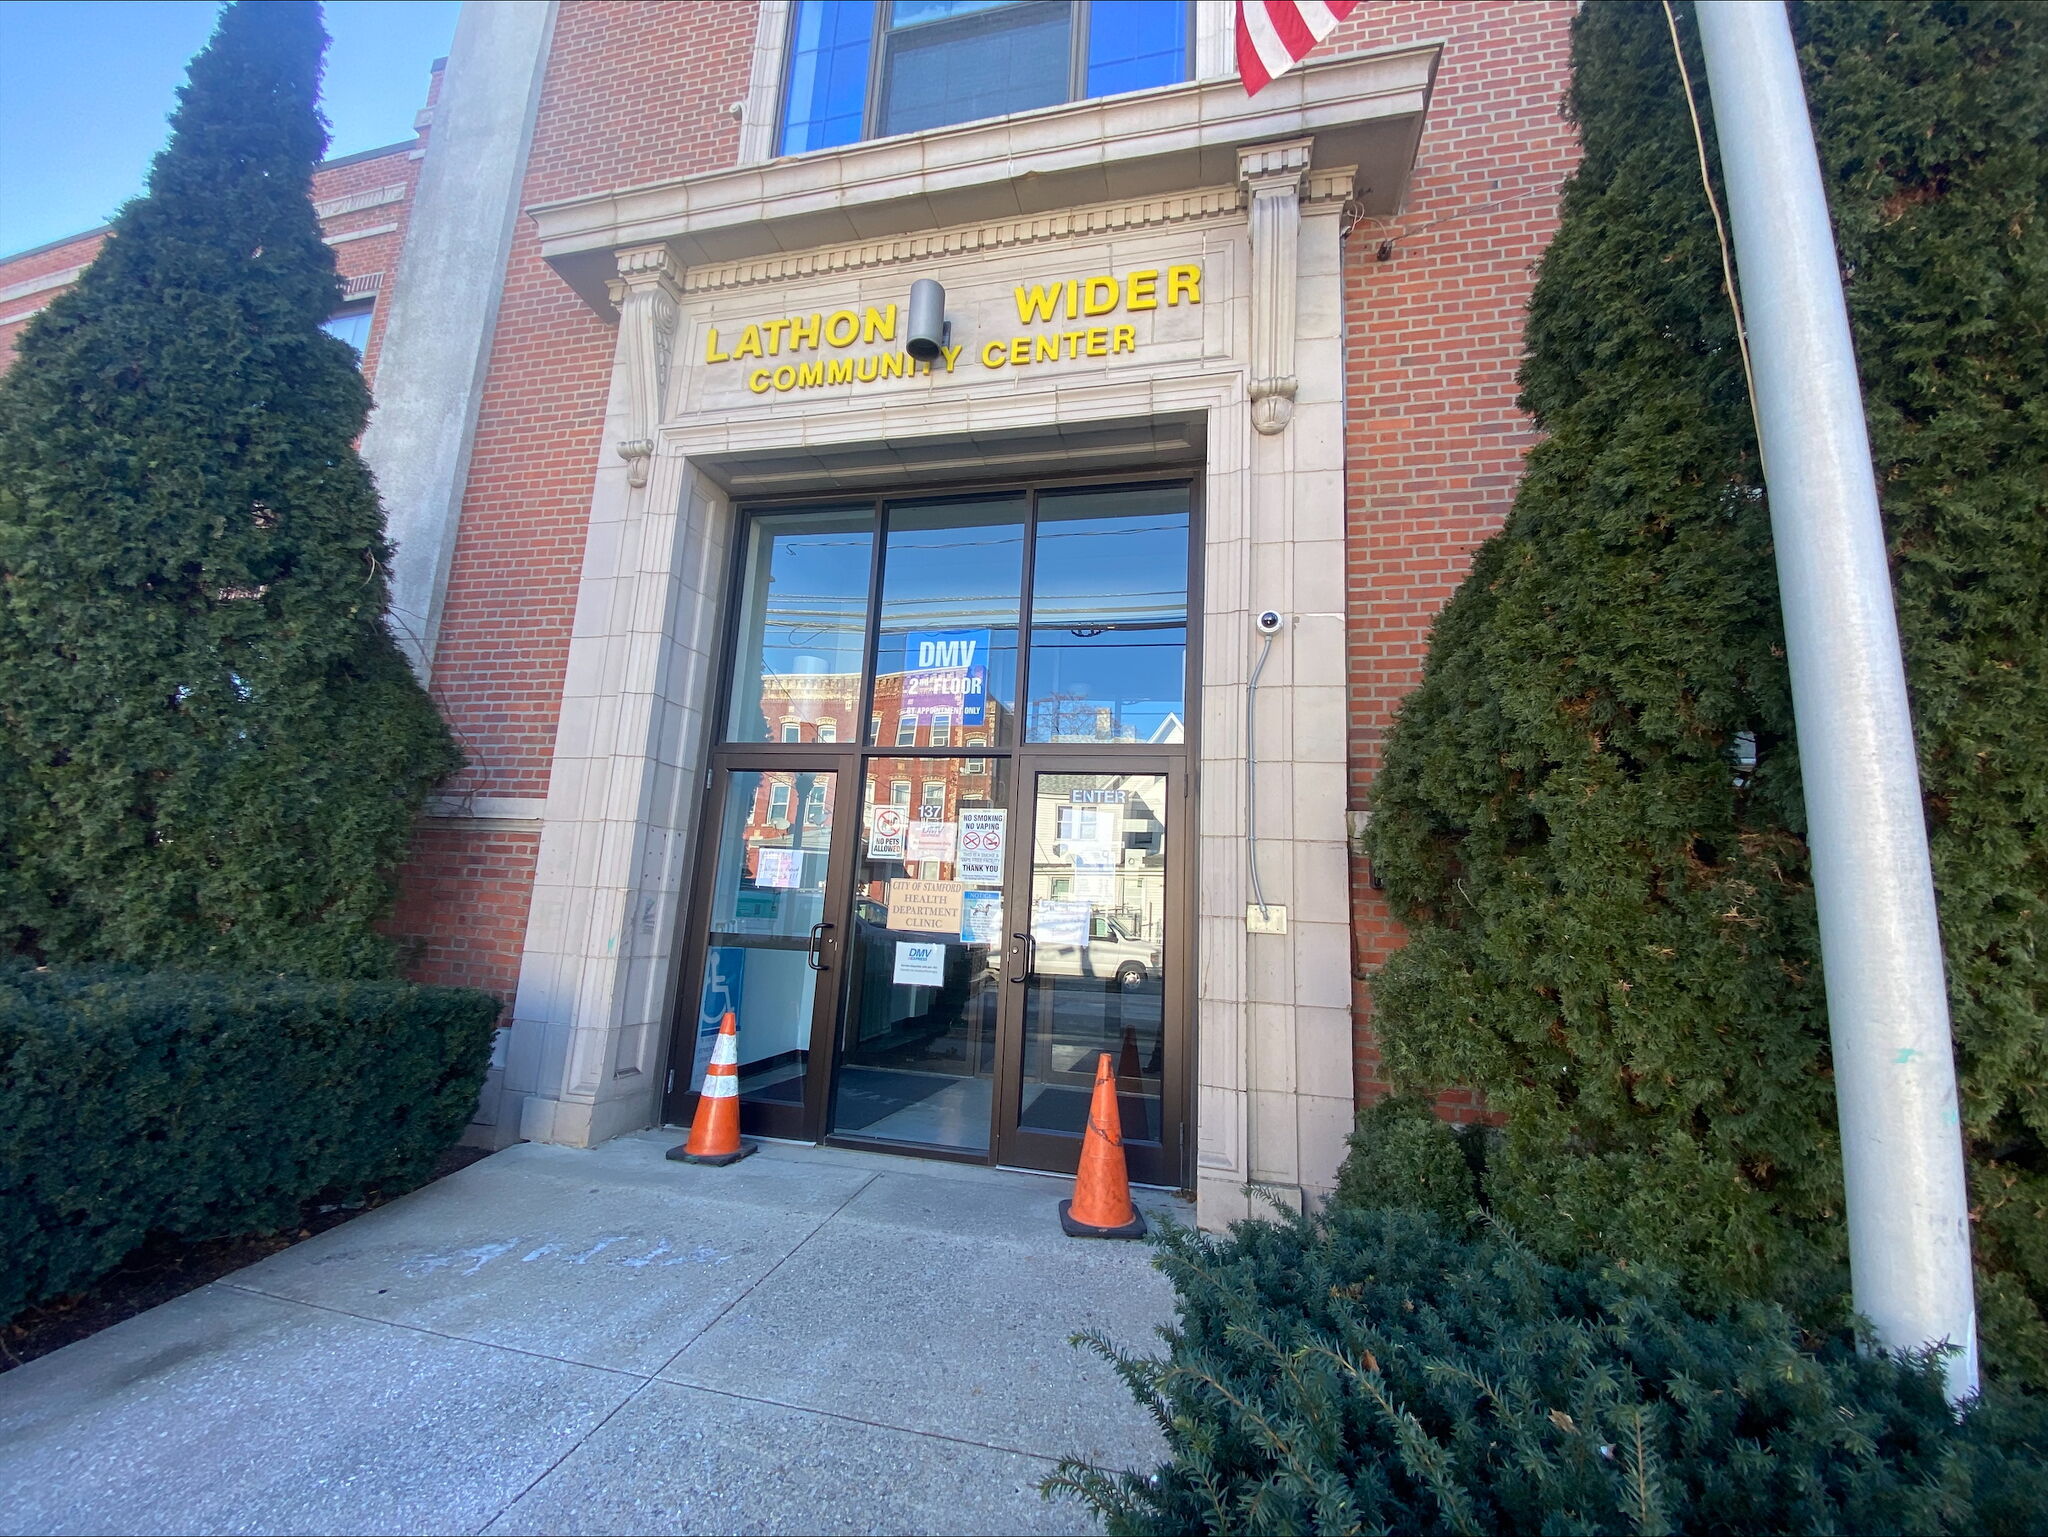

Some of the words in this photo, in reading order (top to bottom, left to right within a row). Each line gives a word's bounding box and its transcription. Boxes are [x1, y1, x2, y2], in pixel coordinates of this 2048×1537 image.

[706, 304, 897, 364] LATHON
[1014, 264, 1201, 324] WIDER
[982, 324, 1136, 369] CENTER
[918, 641, 976, 667] DMV
[933, 677, 982, 695] FLOOR
[964, 706, 981, 715] ONLY
[1072, 790, 1126, 803] ENTER
[918, 805, 941, 818] 137
[963, 814, 972, 822] NO
[973, 814, 1003, 822] SMOKING
[965, 822, 975, 830] NO
[976, 823, 1000, 831] VAPING
[873, 844, 901, 853] ALLOWED
[962, 864, 984, 872] THANK
[893, 881, 910, 890] CITY
[912, 882, 922, 891] OF
[923, 883, 962, 892] STAMFORD
[904, 894, 947, 904] HEALTH
[893, 905, 959, 917] DEPARTMENT
[905, 917, 943, 928] CLINIC
[909, 948, 932, 957] DMV
